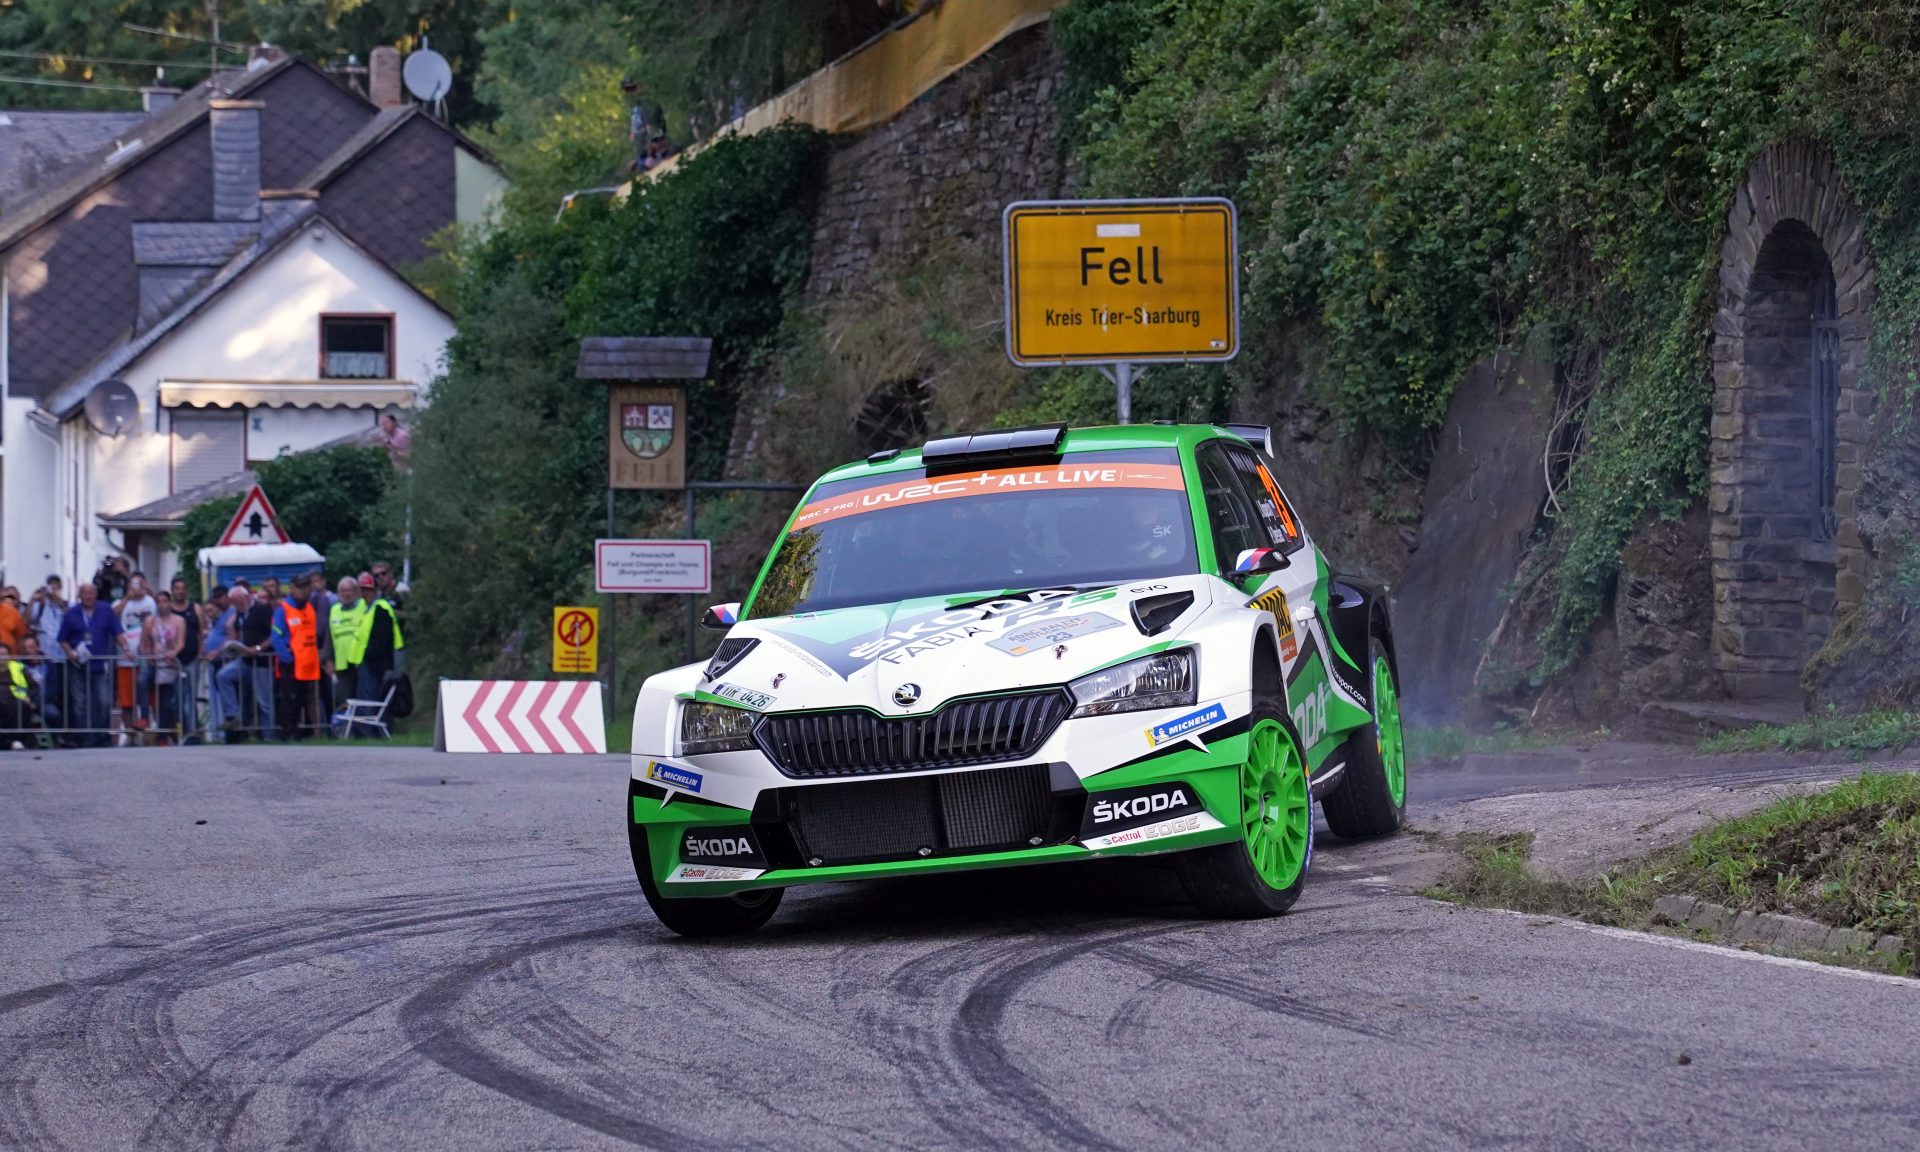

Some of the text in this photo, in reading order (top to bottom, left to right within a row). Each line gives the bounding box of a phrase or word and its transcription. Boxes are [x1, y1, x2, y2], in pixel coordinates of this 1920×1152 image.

[1081, 246, 1163, 285] Fell
[1046, 309, 1082, 326] Kreis
[998, 472, 1049, 487] ALL
[1057, 470, 1116, 483] LIVE
[799, 502, 854, 521] WRC 2 PRO
[1130, 584, 1168, 594] evo
[880, 625, 993, 665] FABIA
[740, 691, 770, 707] 0426
[1169, 710, 1218, 735] MICHELIN
[662, 771, 698, 787] MICHELIN
[1093, 789, 1189, 824] ŠKODA
[1111, 815, 1201, 845] Castrol EDGE
[686, 836, 754, 857] ŠKODA
[684, 867, 750, 880] Castrol EDGE
